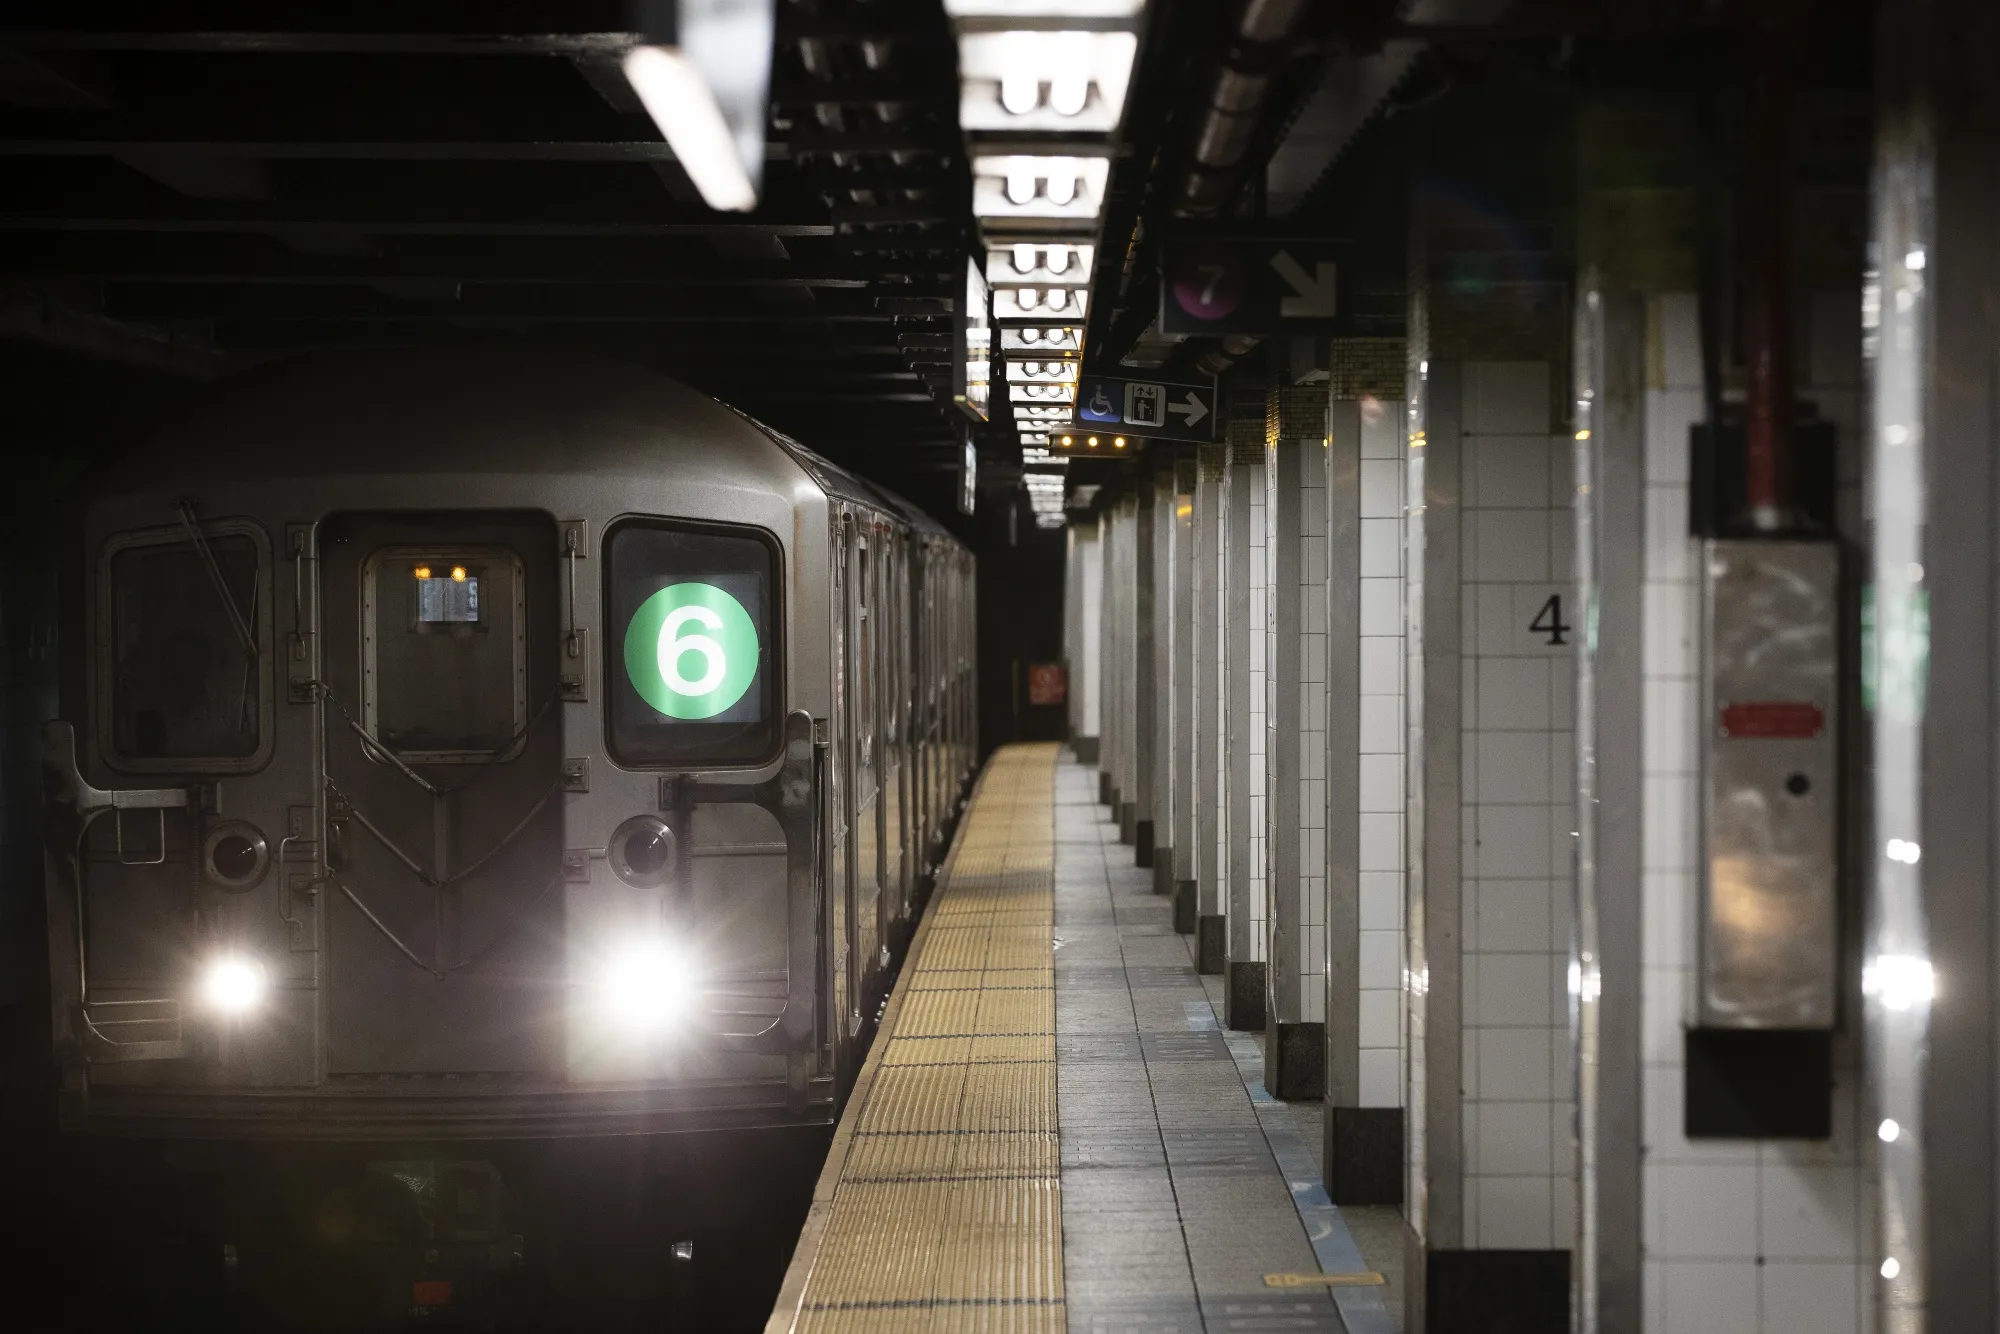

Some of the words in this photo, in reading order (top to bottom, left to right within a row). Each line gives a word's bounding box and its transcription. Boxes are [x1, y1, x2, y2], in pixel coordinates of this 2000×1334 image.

[1199, 265, 1225, 305] 7
[1529, 594, 1570, 645] 4
[657, 605, 726, 697] 6
